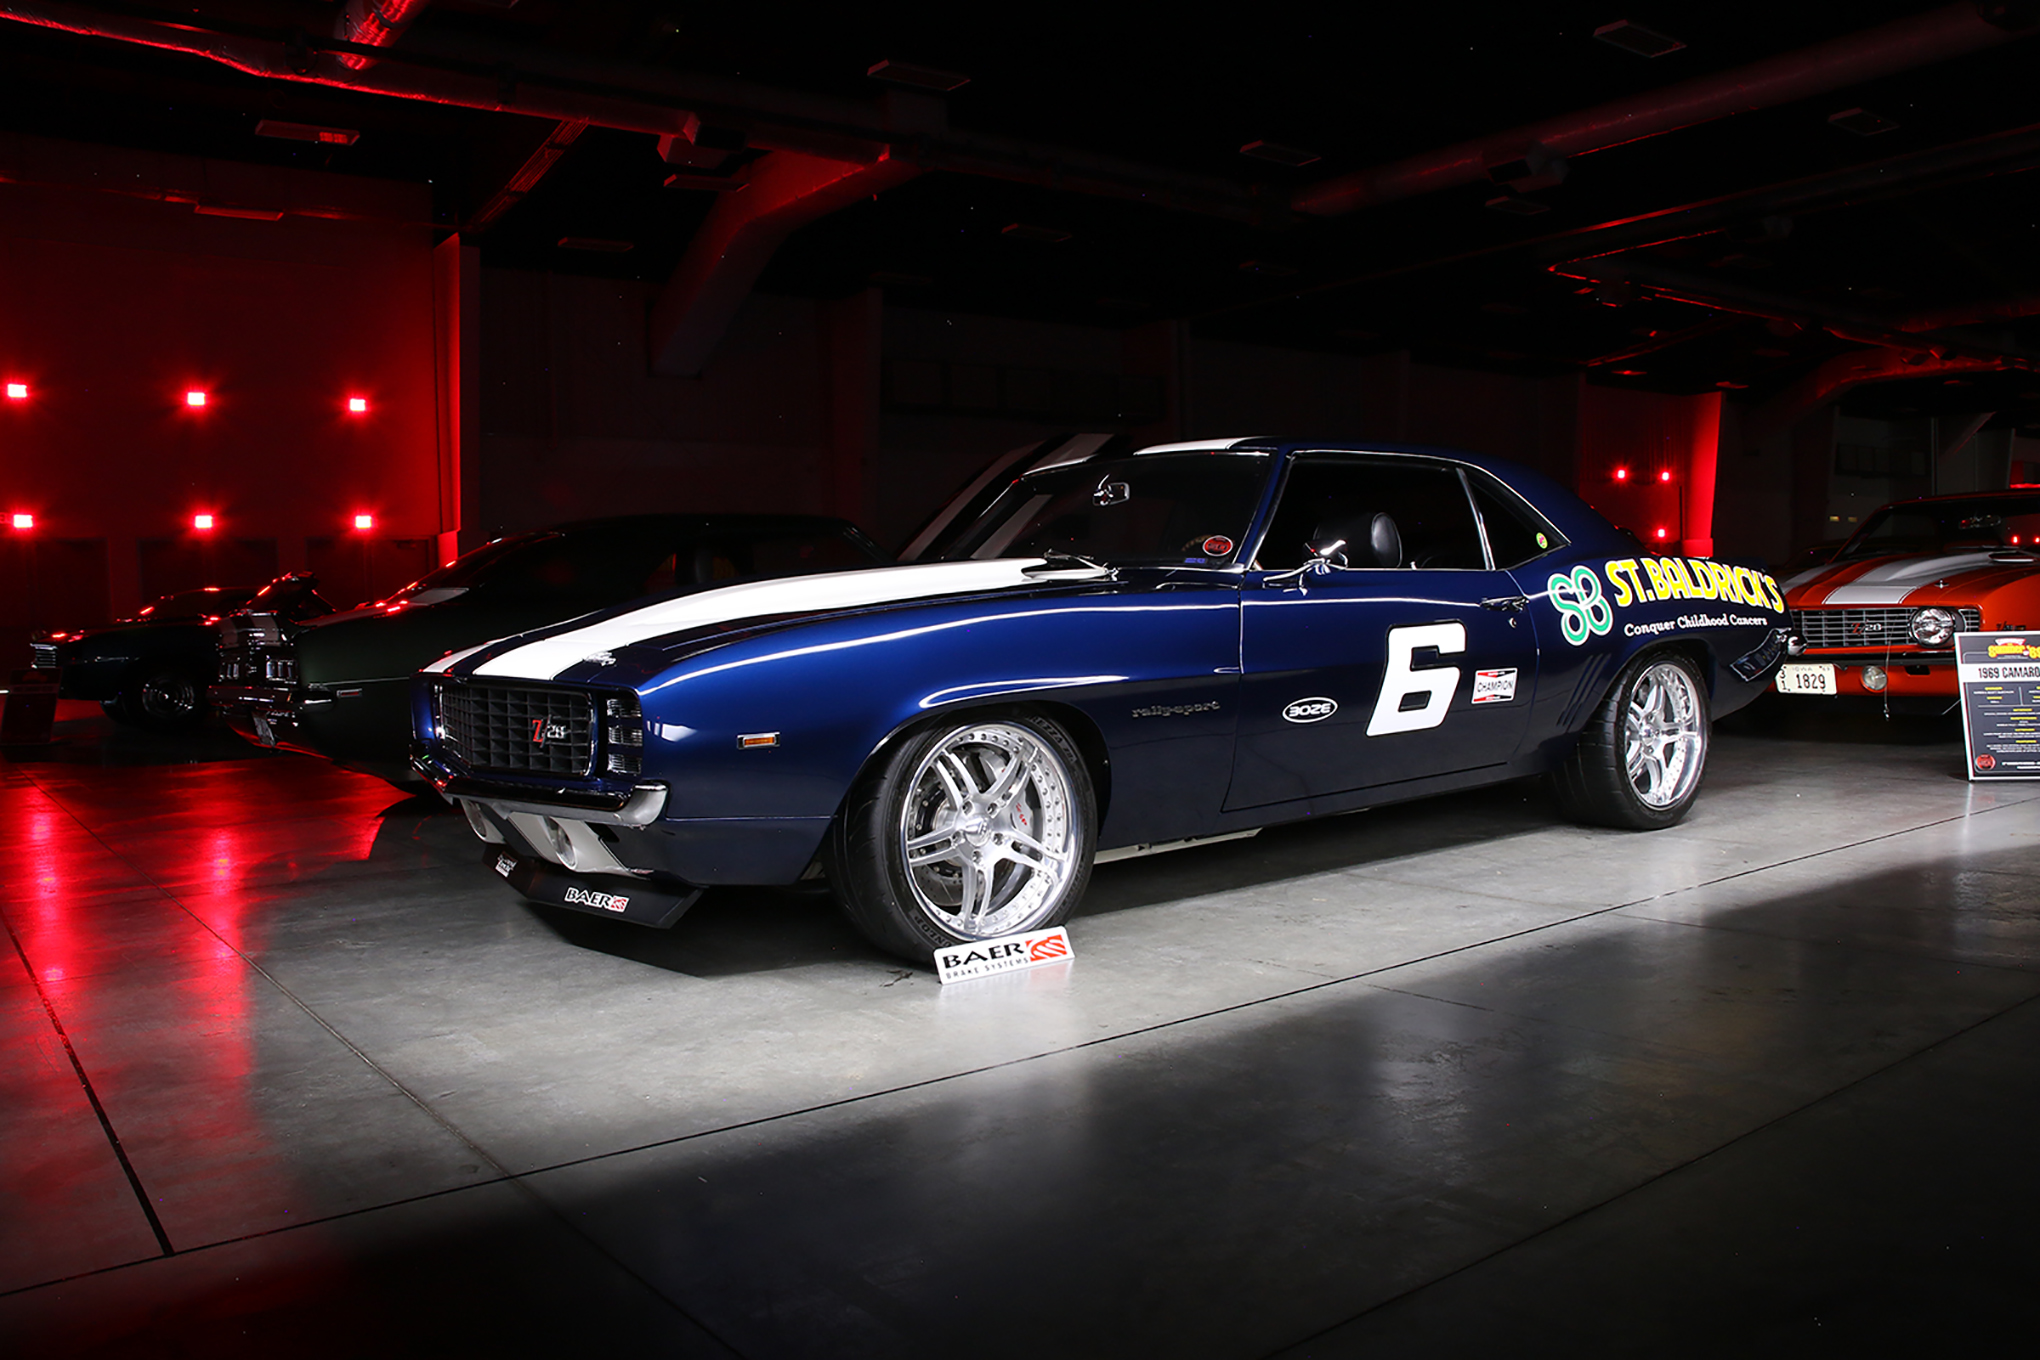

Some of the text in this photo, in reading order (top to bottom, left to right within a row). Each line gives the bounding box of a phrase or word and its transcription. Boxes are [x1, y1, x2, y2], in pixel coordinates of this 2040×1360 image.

[1624, 613, 1768, 637] Conquer Childhood Cancers
[1365, 620, 1467, 737] 6
[1796, 673, 1827, 690] 1829
[1978, 666, 2040, 679] 1969 CAMARO
[1476, 680, 1515, 692] CHAMPION
[564, 886, 612, 908] BAER
[942, 942, 1025, 969] BAER
[945, 956, 1030, 980] BRAKE SYSTEMS
